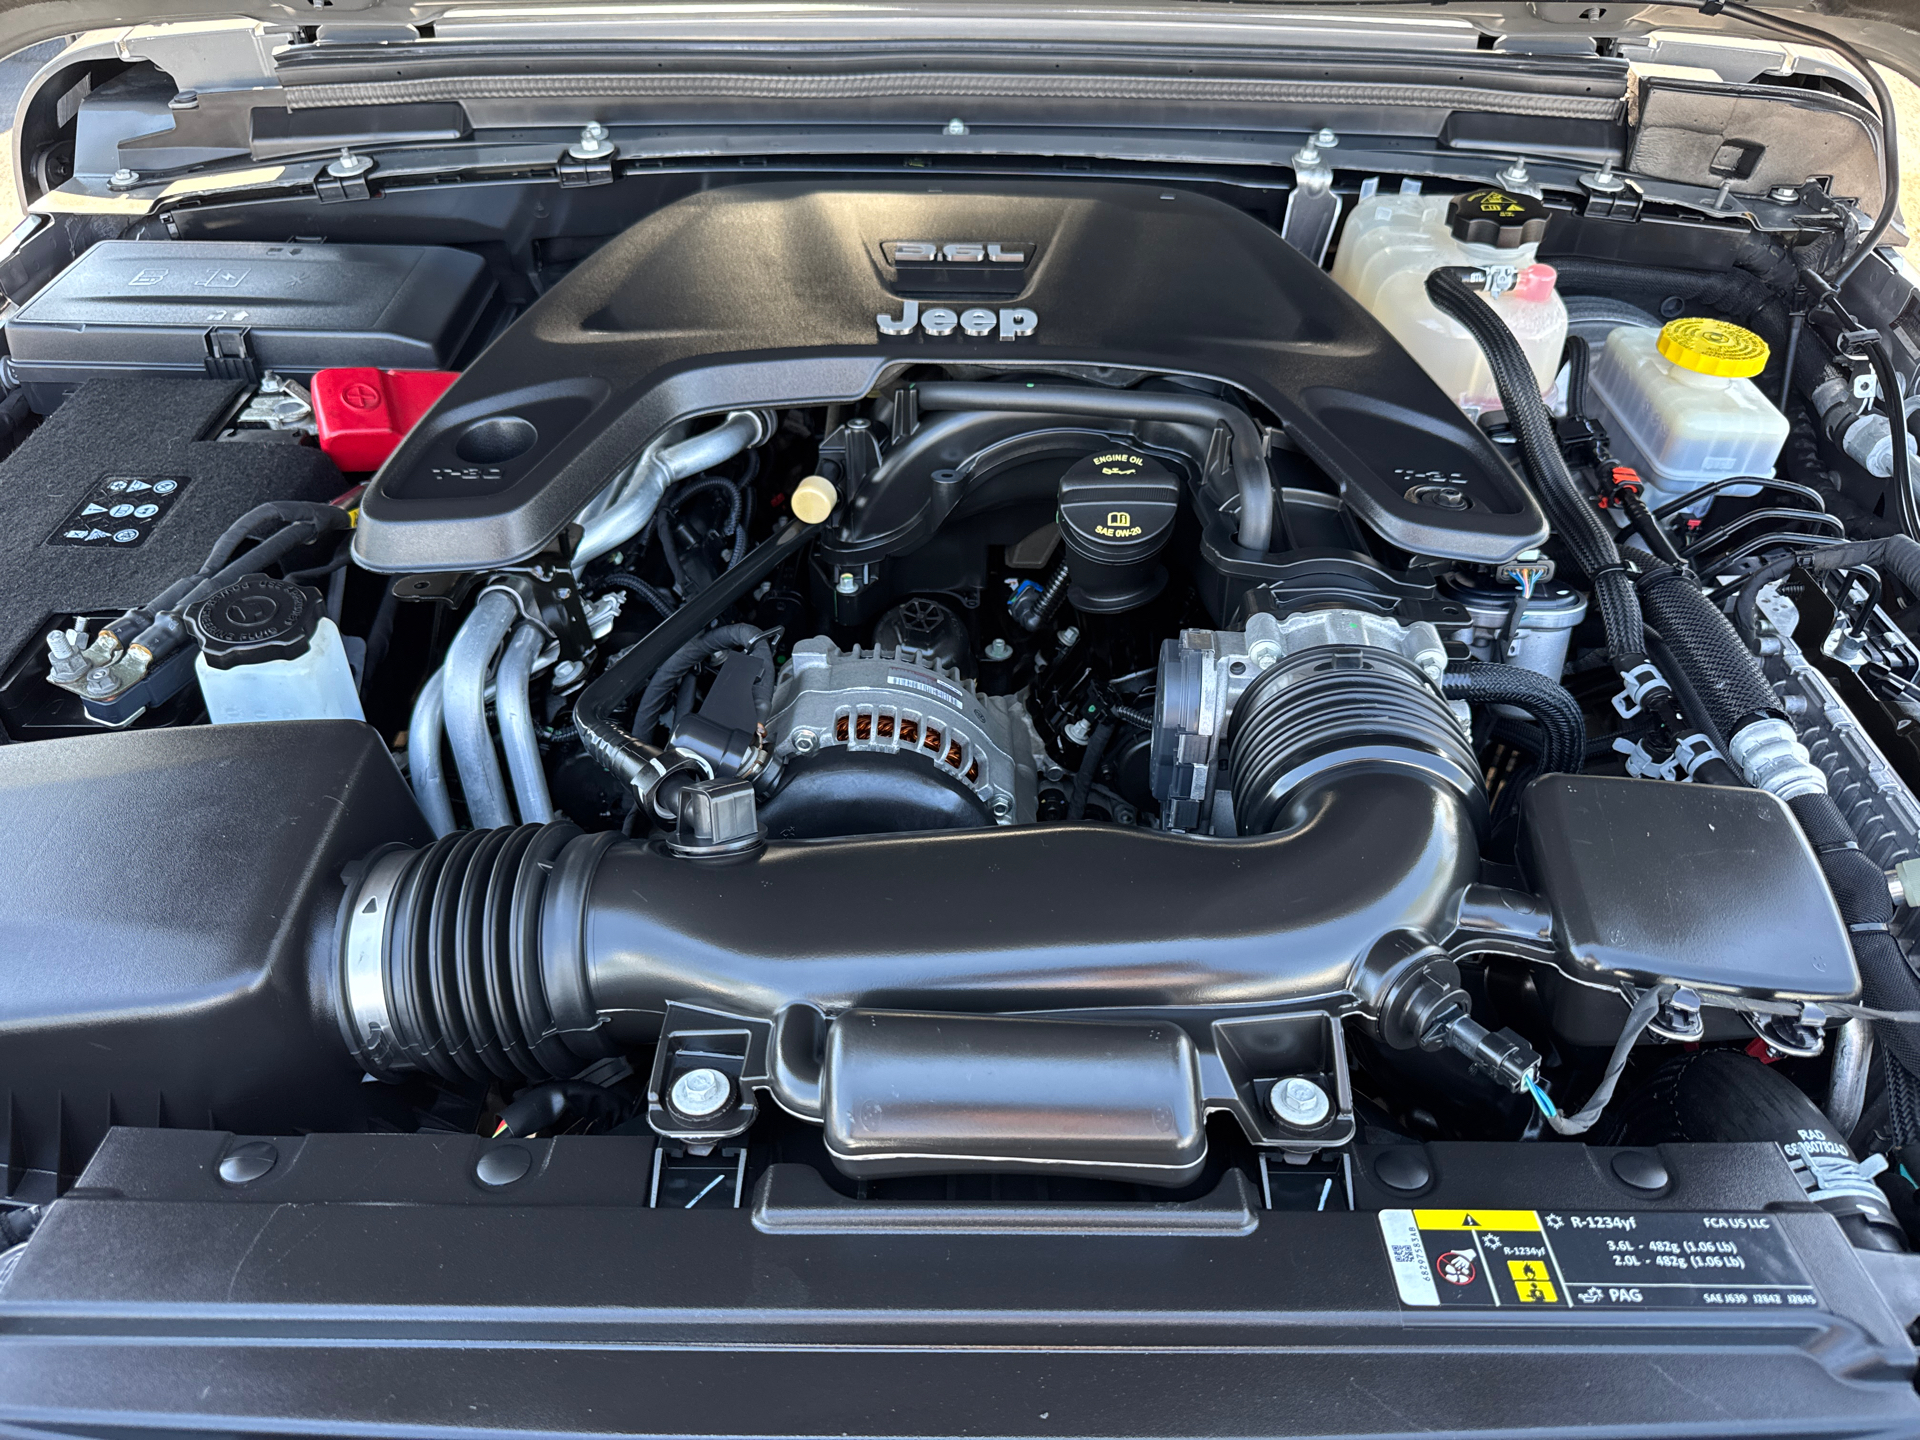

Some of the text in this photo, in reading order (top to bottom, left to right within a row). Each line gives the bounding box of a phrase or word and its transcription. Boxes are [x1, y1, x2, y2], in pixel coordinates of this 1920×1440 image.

[895, 241, 1025, 262] 3.6L
[876, 300, 1039, 342] Jeep
[1093, 454, 1144, 466] ENGINE OIL
[1095, 525, 1142, 537] SAE 0W-20
[1797, 1129, 1826, 1141] RAD
[1784, 1141, 1849, 1157] 6880782AD
[1571, 1216, 1636, 1231] R-1234yf
[1704, 1217, 1770, 1230] FCA US LLC
[1503, 1247, 1546, 1258] R-1234yf
[1606, 1240, 1634, 1252] 3.6L
[1650, 1241, 1681, 1254] 482g
[1683, 1241, 1715, 1254] (1.06
[1409, 1226, 1432, 1283] 68297583AB
[1613, 1255, 1642, 1267] 2.0L
[1656, 1256, 1688, 1269] 482g
[1690, 1256, 1723, 1269] (1.06
[1609, 1288, 1643, 1302] PAG
[1703, 1293, 1724, 1304] SAE
